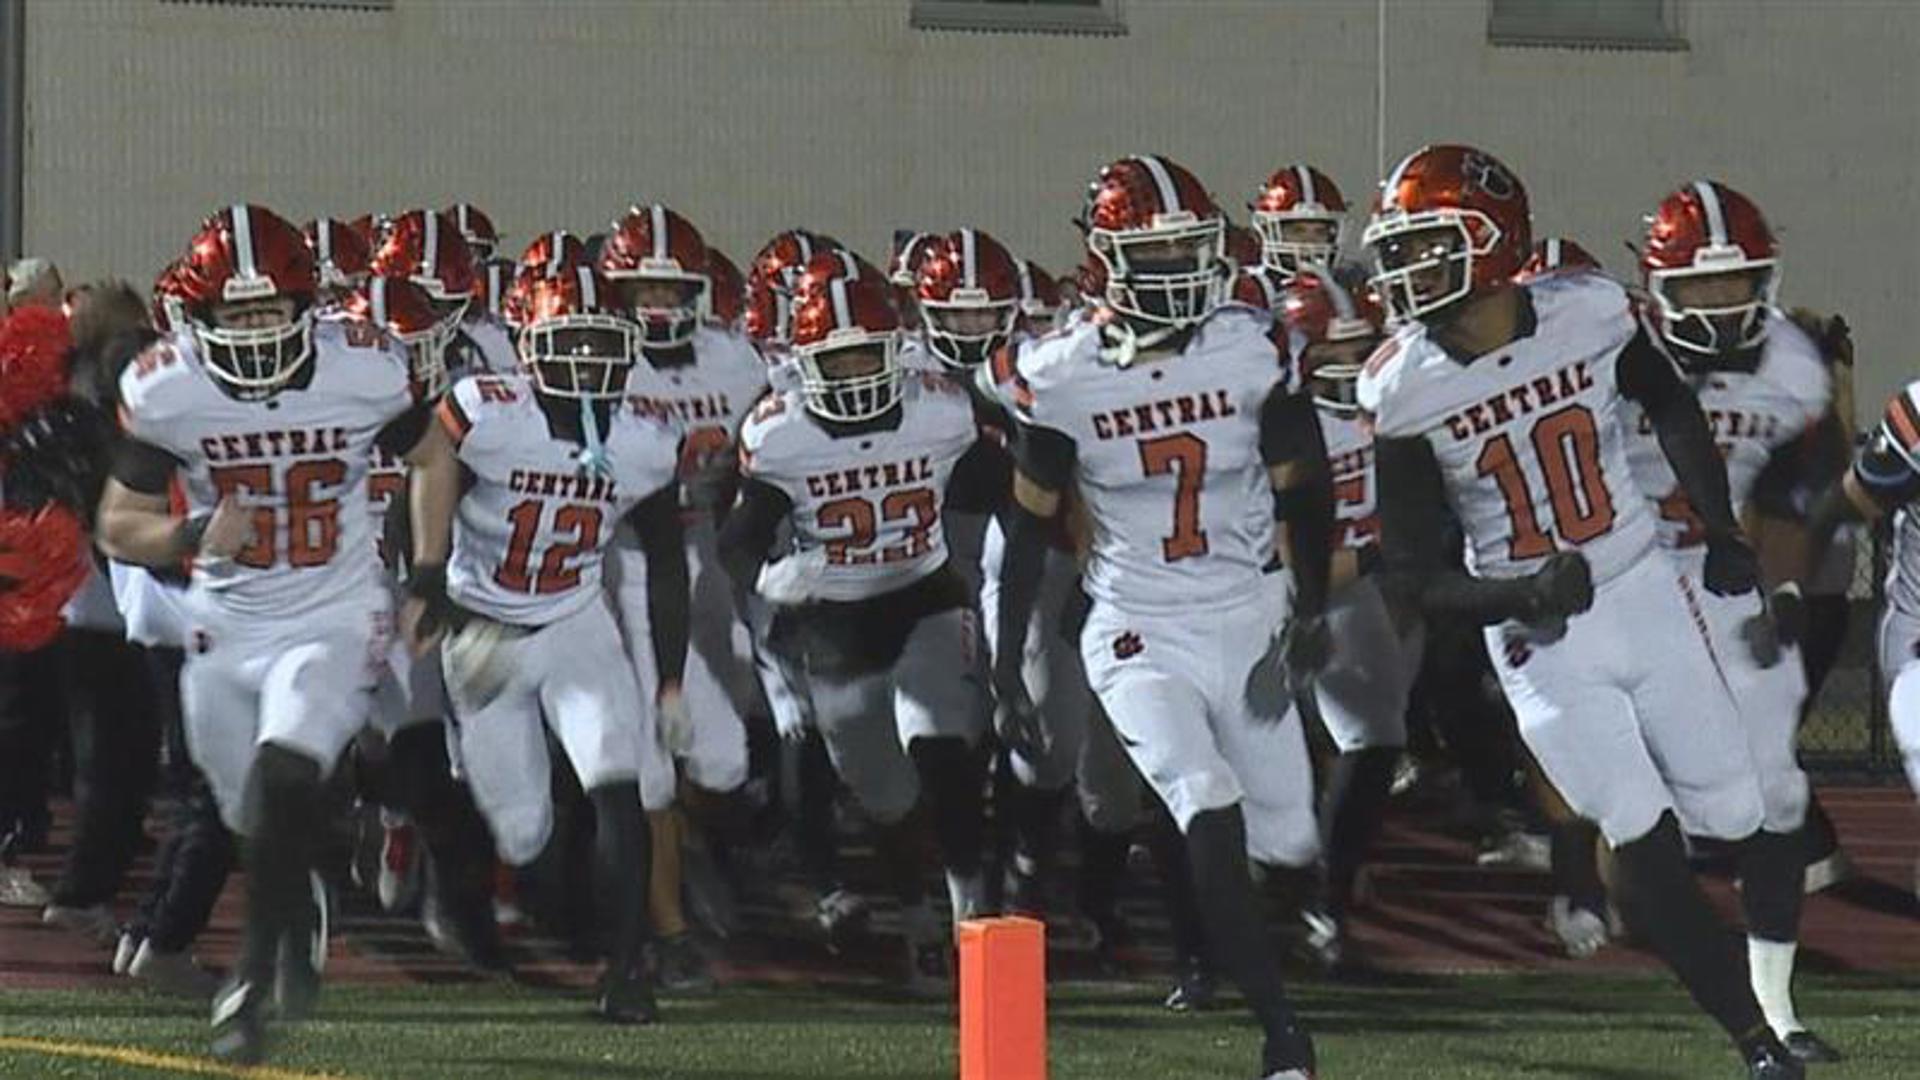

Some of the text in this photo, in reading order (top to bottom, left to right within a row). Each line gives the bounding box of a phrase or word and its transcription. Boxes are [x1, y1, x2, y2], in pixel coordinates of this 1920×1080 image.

[1092, 390, 1236, 440] CENTRAL
[1444, 362, 1594, 441] CENTRAL
[201, 428, 348, 462] CENTRAL
[806, 456, 933, 498] CENTRAL
[1476, 403, 1616, 561] 10
[210, 459, 349, 569] 56
[509, 468, 618, 502] CENTRAL
[1137, 431, 1209, 563] 7
[494, 498, 604, 595] 12
[816, 487, 938, 566] 23
